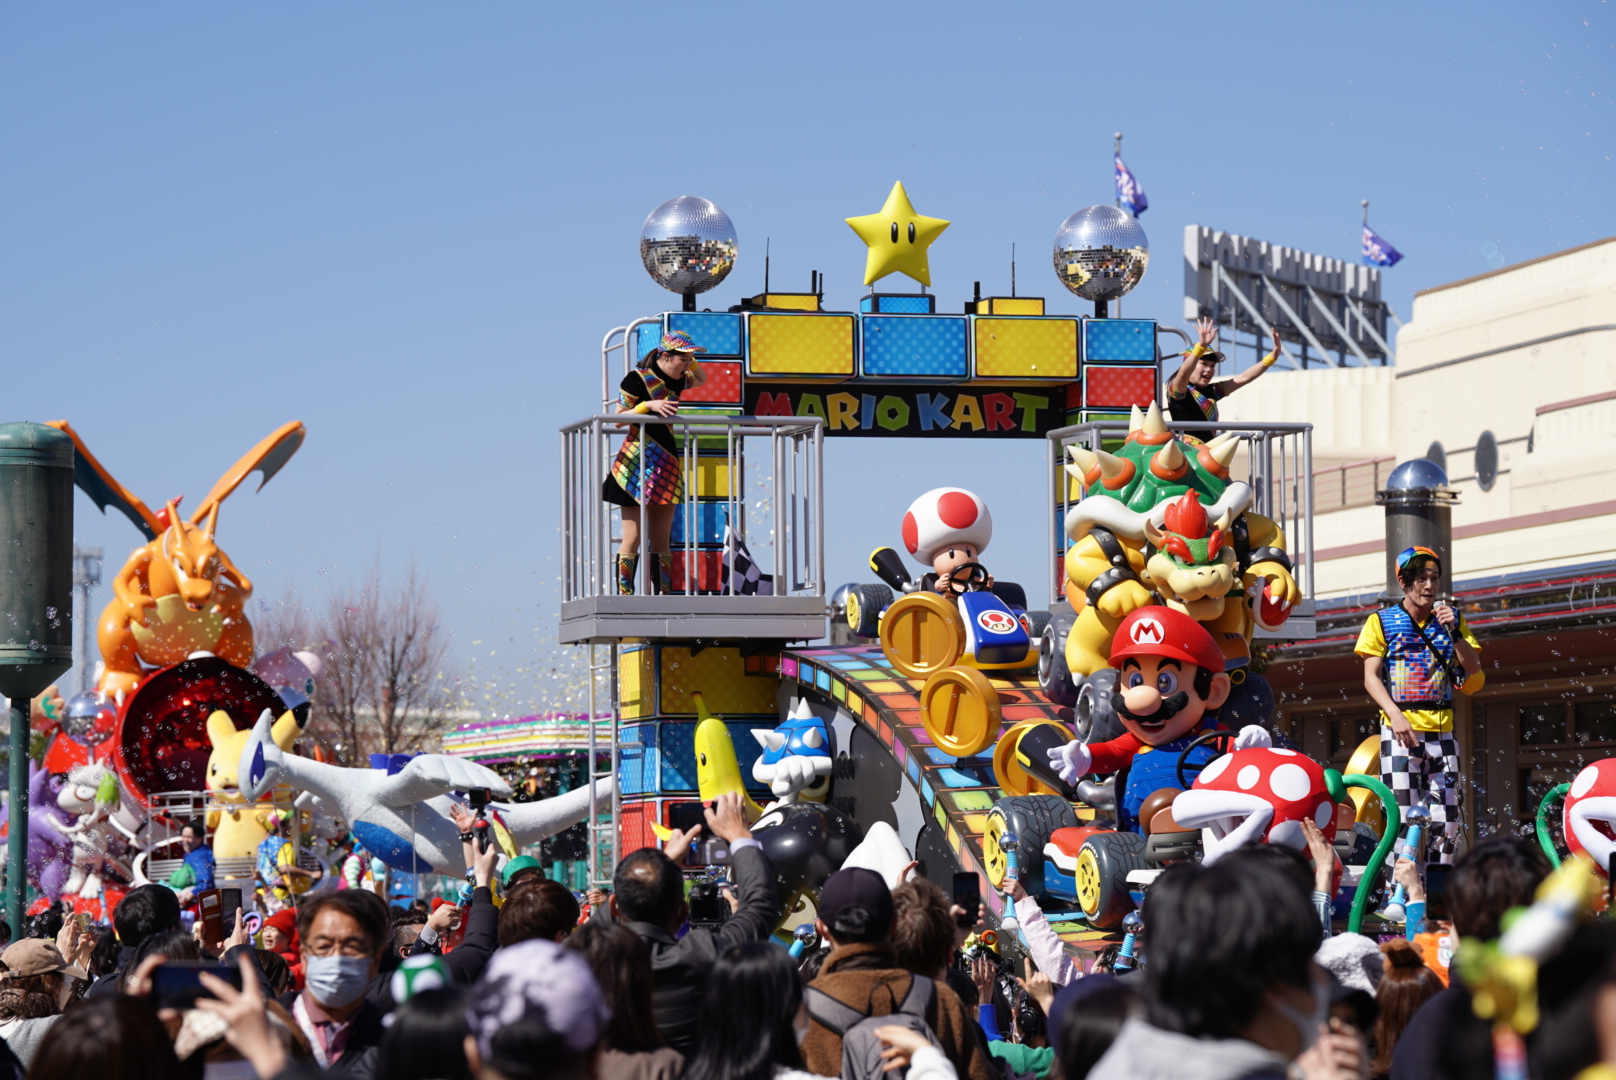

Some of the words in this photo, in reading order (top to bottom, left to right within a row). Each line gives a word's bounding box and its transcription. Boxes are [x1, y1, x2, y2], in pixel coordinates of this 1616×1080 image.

[753, 392, 910, 432] MARIO
[916, 392, 1049, 432] KART
[1133, 621, 1162, 643] M
